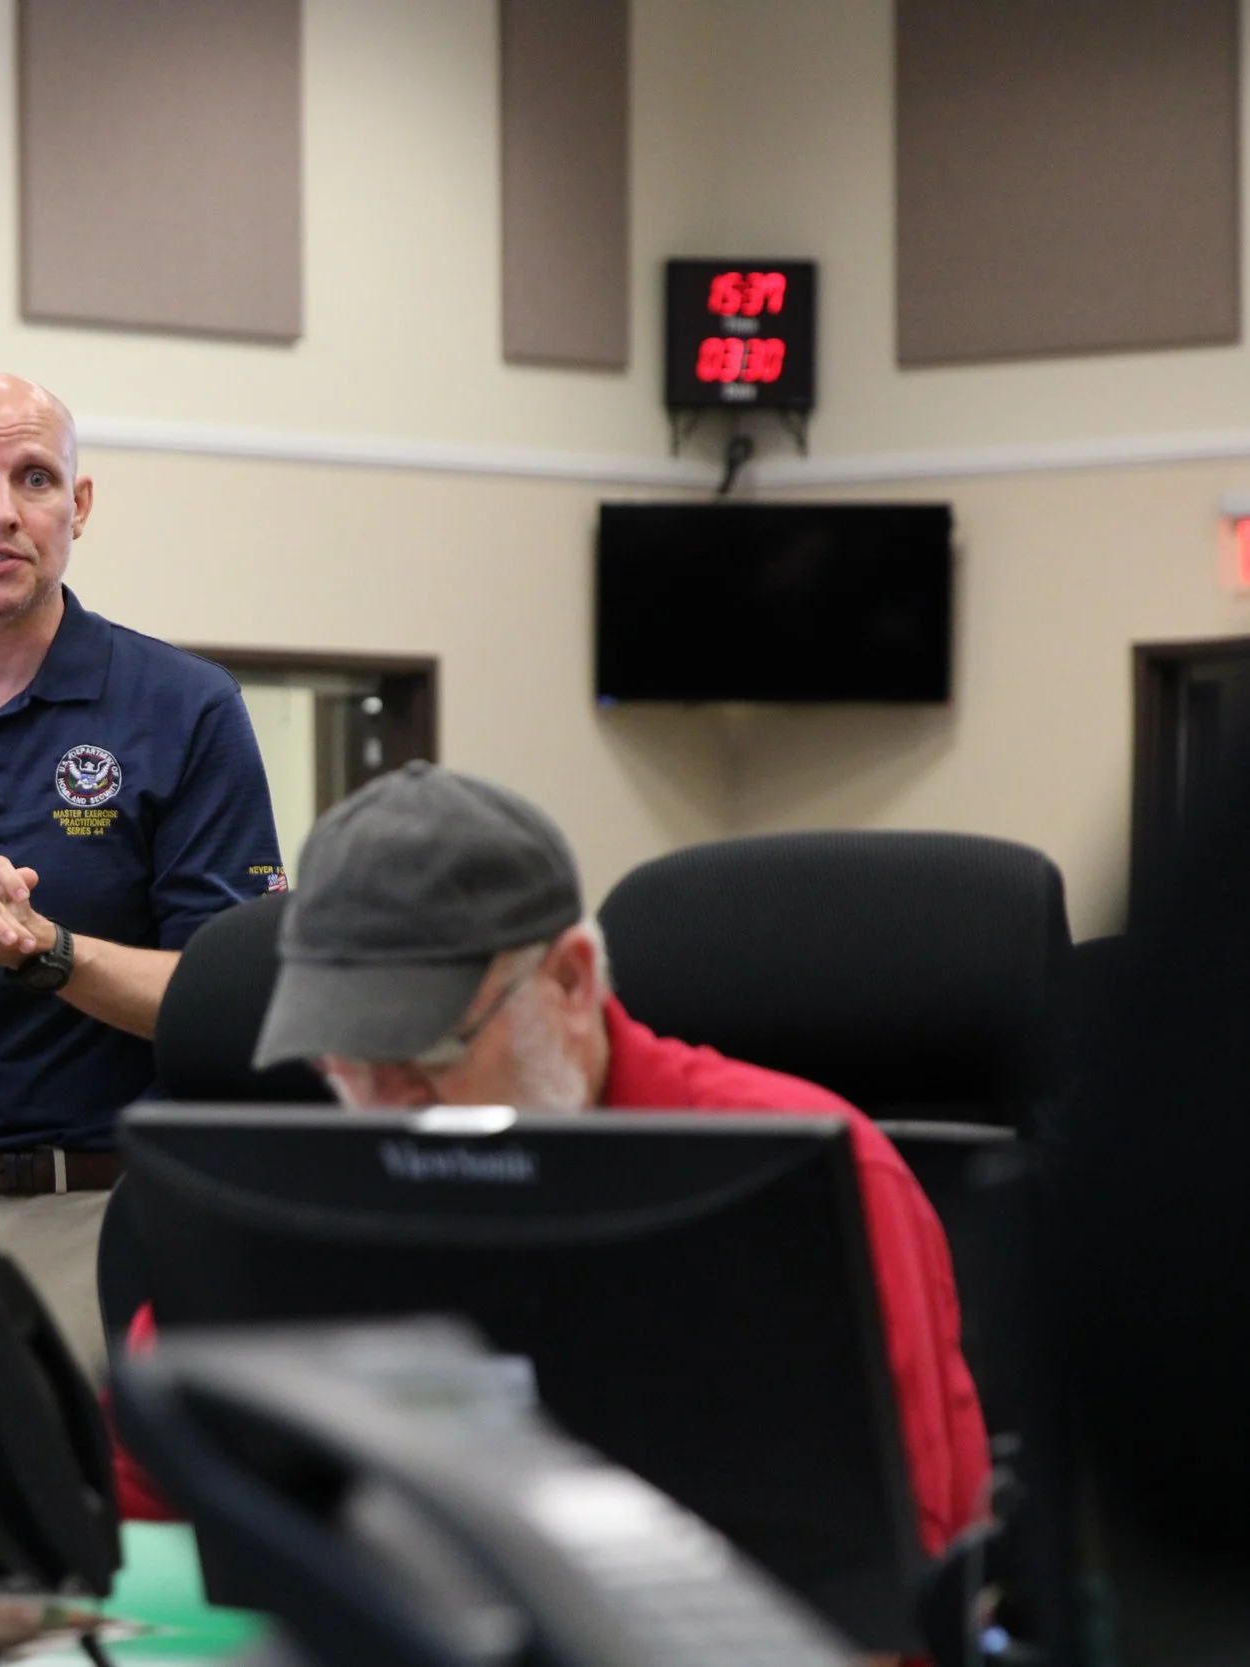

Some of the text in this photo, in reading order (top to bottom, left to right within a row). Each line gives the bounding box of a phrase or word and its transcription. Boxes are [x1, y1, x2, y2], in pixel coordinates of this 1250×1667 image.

[68, 747, 115, 767] DEPARTMENT
[57, 777, 119, 804] HOMELAND SECURITY
[53, 809, 118, 818] MASTER EXERCISE
[59, 818, 111, 827] PRACTITIONER
[66, 826, 91, 835] SERIES
[249, 865, 273, 874] NEVER
